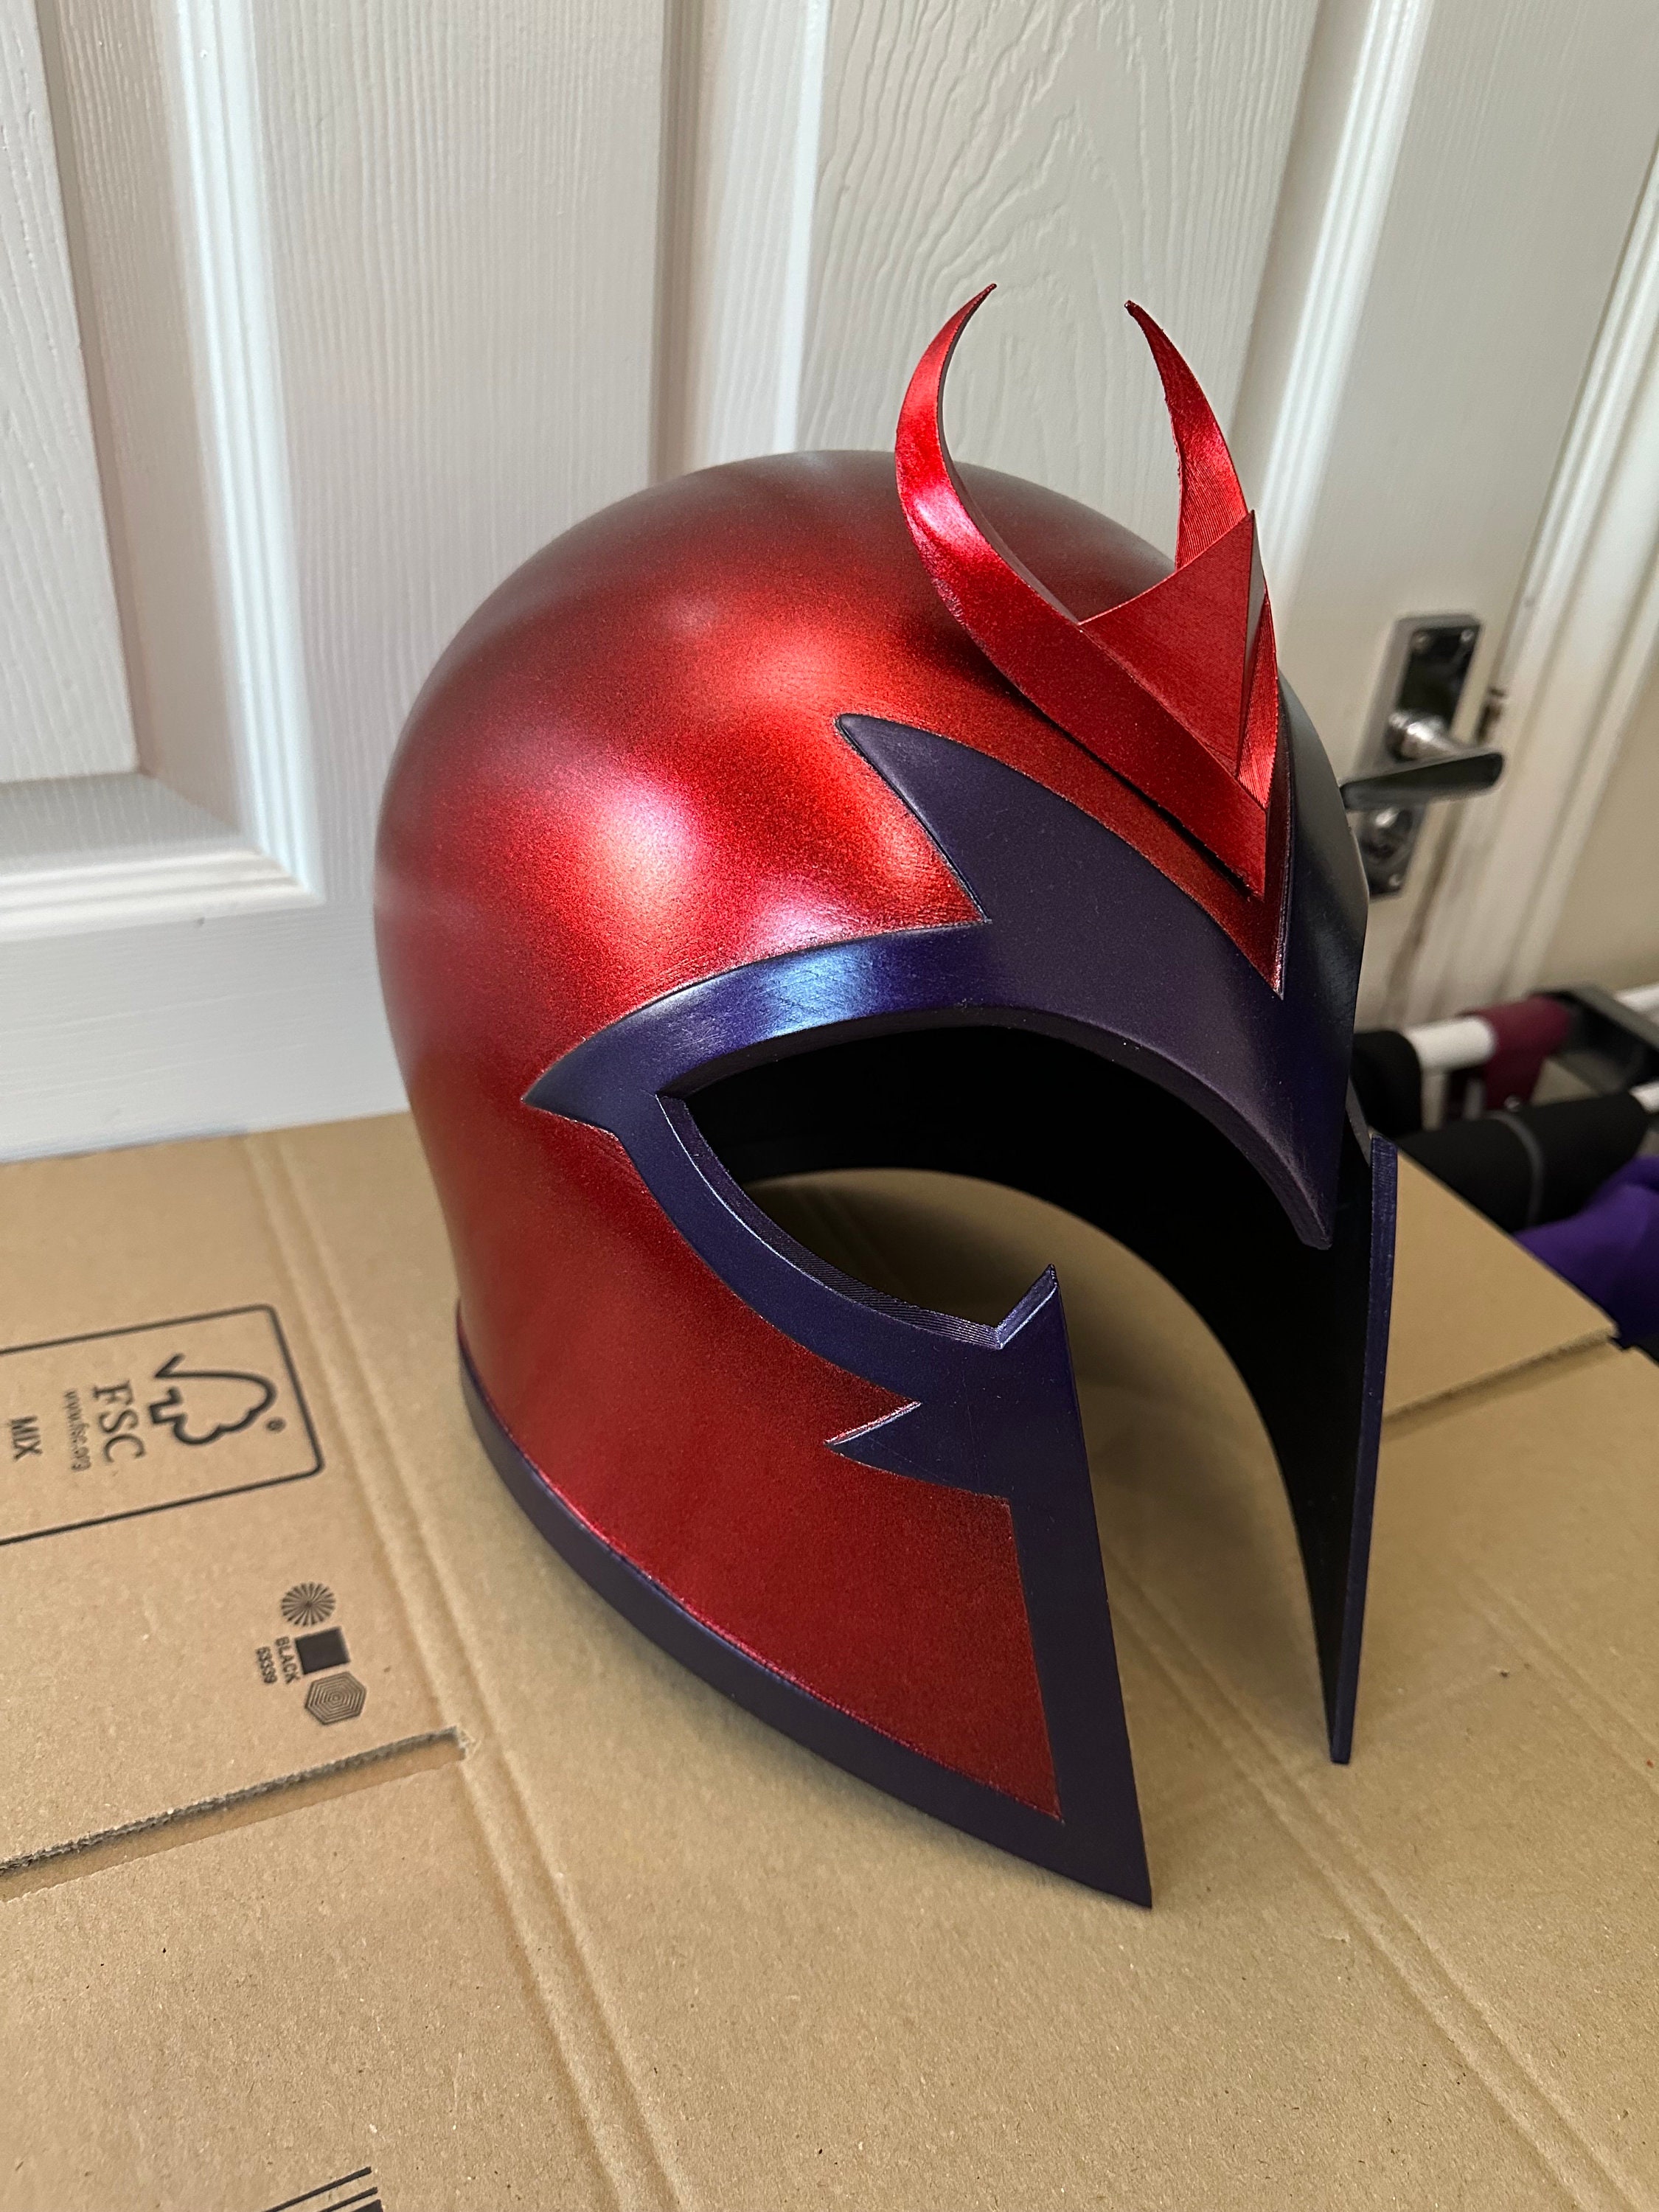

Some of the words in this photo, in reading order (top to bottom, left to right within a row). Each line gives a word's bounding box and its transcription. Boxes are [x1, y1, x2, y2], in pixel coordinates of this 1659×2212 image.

[10, 1415, 43, 1461] MIX
[64, 1388, 91, 1472] www.fsc.org
[92, 1380, 145, 1463] FSC
[275, 1636, 301, 1684] BLACK
